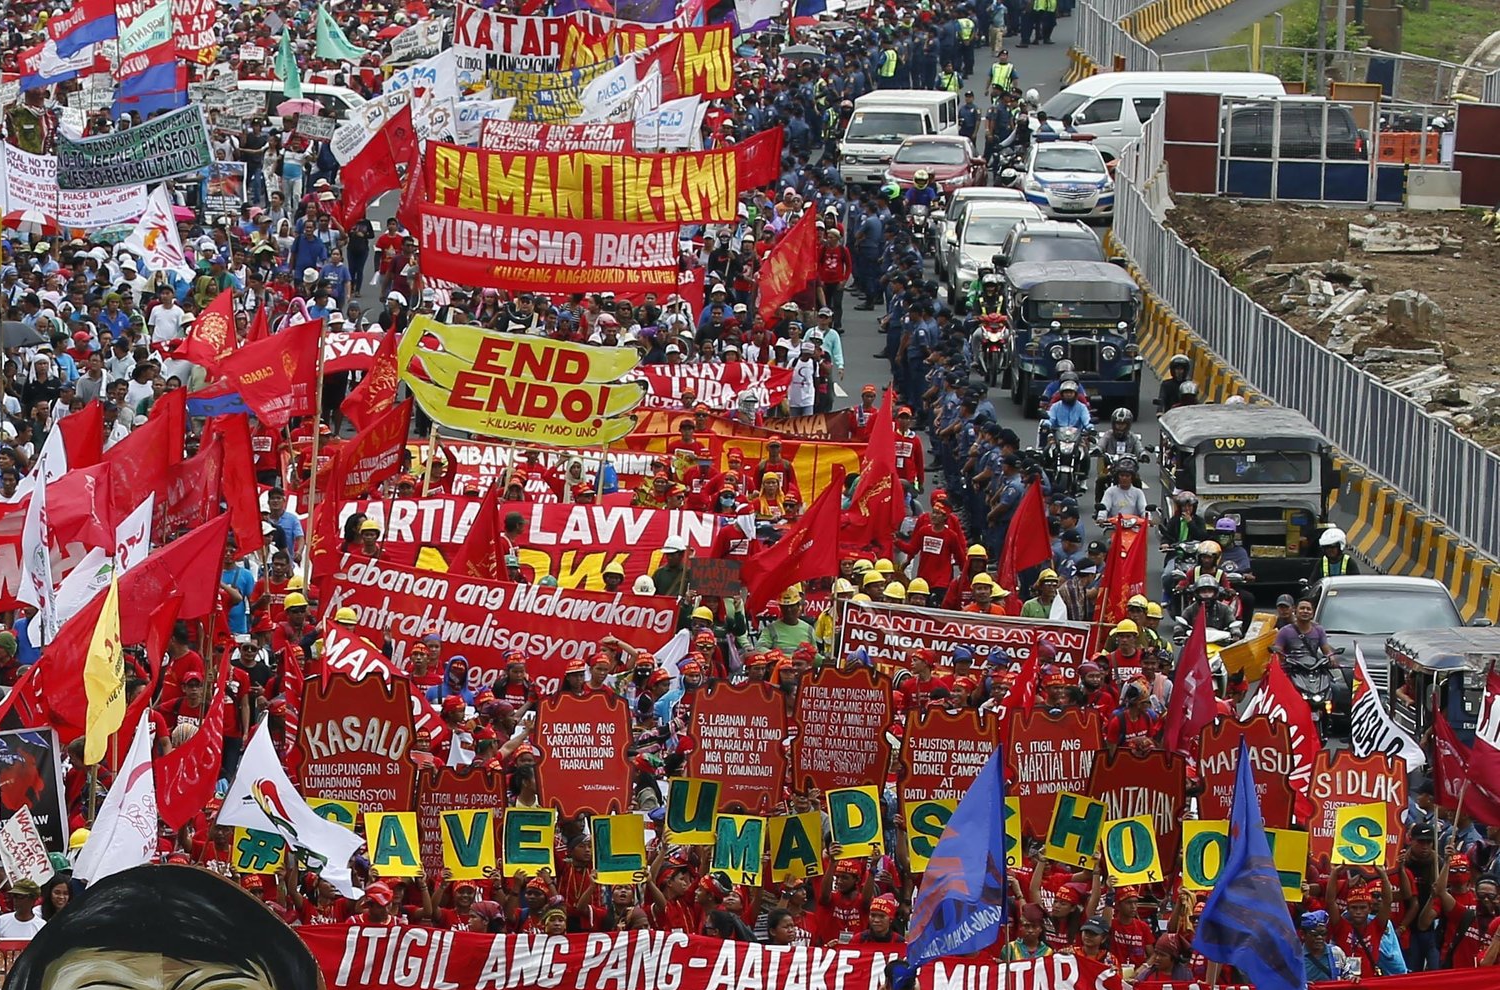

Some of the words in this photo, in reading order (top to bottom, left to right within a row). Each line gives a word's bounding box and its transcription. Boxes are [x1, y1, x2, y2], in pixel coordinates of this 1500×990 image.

[582, 125, 613, 140] MGA
[142, 126, 202, 158] PHASEOUT
[107, 150, 201, 184] REHABILITATION
[435, 146, 737, 222] PAMANTIK-KMU
[493, 265, 552, 283] KILUSANG
[554, 267, 624, 284] MAGBUBUKID
[626, 269, 640, 283] NG
[472, 337, 590, 385] END
[447, 371, 612, 429] ENDO!
[543, 424, 574, 437] MAYO
[576, 426, 598, 438] UNO
[528, 503, 656, 546] LAW
[671, 507, 718, 548] IN
[332, 552, 449, 599] Labanan
[454, 579, 506, 612] ang
[509, 581, 675, 634] Malawakang
[850, 628, 877, 642] NG
[884, 635, 925, 649] MGA
[864, 702, 885, 714] KASO
[698, 714, 707, 725] 3.
[710, 714, 746, 726] LABANAN
[751, 716, 768, 728] ANG
[803, 711, 828, 723] LABAN
[831, 713, 841, 723] SA
[542, 723, 550, 734] 2.
[553, 723, 591, 734] IGALANG
[596, 723, 615, 734] ANG
[744, 728, 755, 739] SA
[756, 728, 781, 740] LUMAD
[805, 724, 826, 735] GURO
[828, 725, 839, 736] SA
[304, 716, 409, 760] KASALO
[547, 735, 594, 745] KARAPATAN
[600, 735, 612, 745] SA
[909, 737, 917, 748] 5.
[919, 738, 955, 750] HUSTISYA
[958, 740, 974, 752] PARA
[702, 739, 712, 750] NA
[715, 739, 753, 751] PAARALAN
[757, 742, 768, 752] AT
[1015, 742, 1023, 753] 6.
[1030, 741, 1055, 753] ITIGIL
[1061, 739, 1080, 750] ANG
[551, 747, 614, 758] ALTERNATIBONG
[705, 752, 721, 763] MGA
[725, 753, 744, 764] GURO
[749, 753, 760, 764] SA
[913, 750, 948, 763] EMERITO
[387, 764, 400, 775] SA
[560, 759, 604, 770] PAARALAN!
[913, 764, 944, 776] DIONEL
[1018, 752, 1067, 783] MARTIAL
[1071, 750, 1095, 779] LAW
[305, 777, 362, 788] LUMADNONG
[1314, 771, 1402, 805] SIDLAK
[318, 790, 396, 801] ORGANISASYON
[904, 788, 927, 800] DATU
[1019, 784, 1031, 795] SA
[454, 794, 469, 805] ANG
[336, 926, 459, 990] ITIGIL
